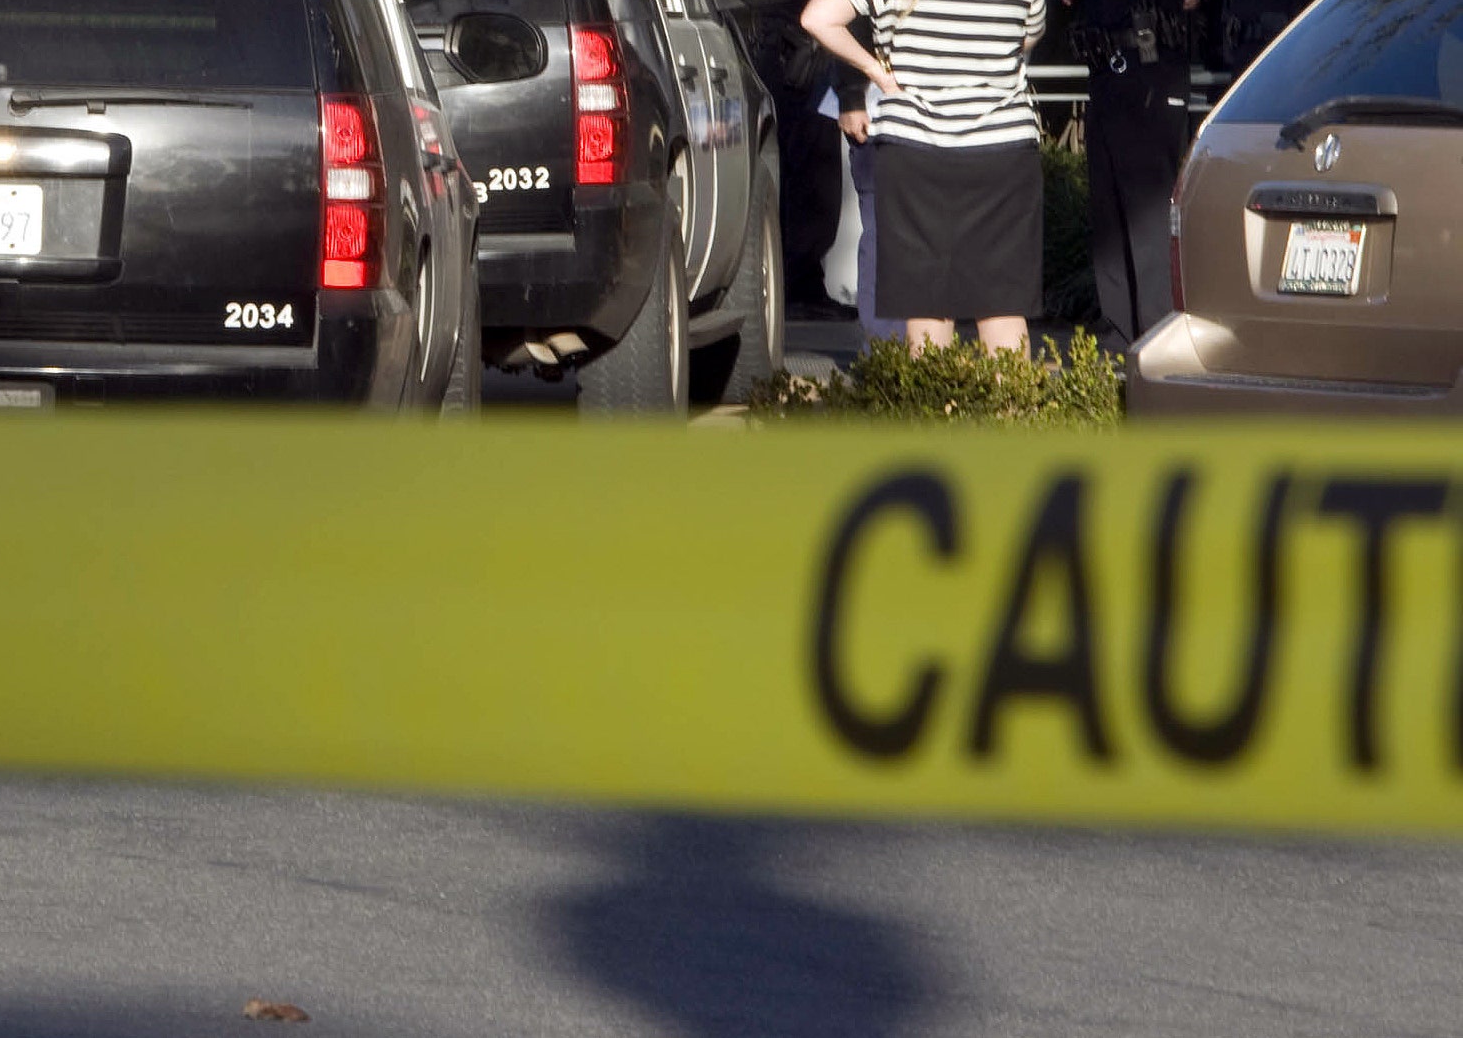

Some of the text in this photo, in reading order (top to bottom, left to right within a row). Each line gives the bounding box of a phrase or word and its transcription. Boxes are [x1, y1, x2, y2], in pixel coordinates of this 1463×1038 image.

[488, 166, 550, 191] 2032
[223, 302, 294, 329] 2034
[805, 464, 1463, 772] CAUT
